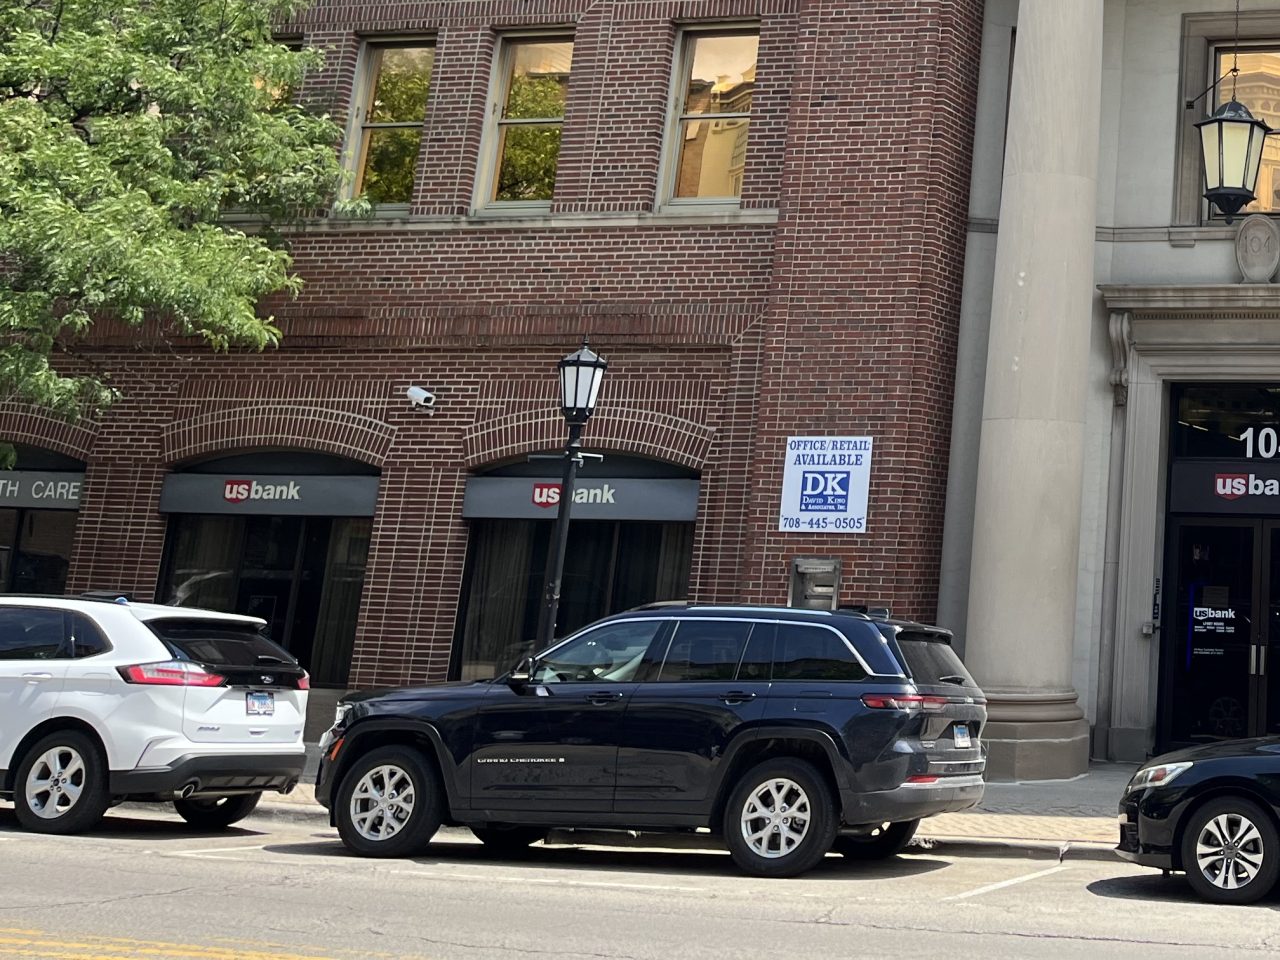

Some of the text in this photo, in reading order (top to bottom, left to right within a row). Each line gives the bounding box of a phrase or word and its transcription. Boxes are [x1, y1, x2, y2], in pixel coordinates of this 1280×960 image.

[789, 440, 870, 452] OFFICE/RETAIL
[793, 453, 863, 466] AVAILABLE
[31, 480, 81, 500] CARE
[802, 472, 848, 496] DK
[783, 517, 863, 529] 708-445-0505
